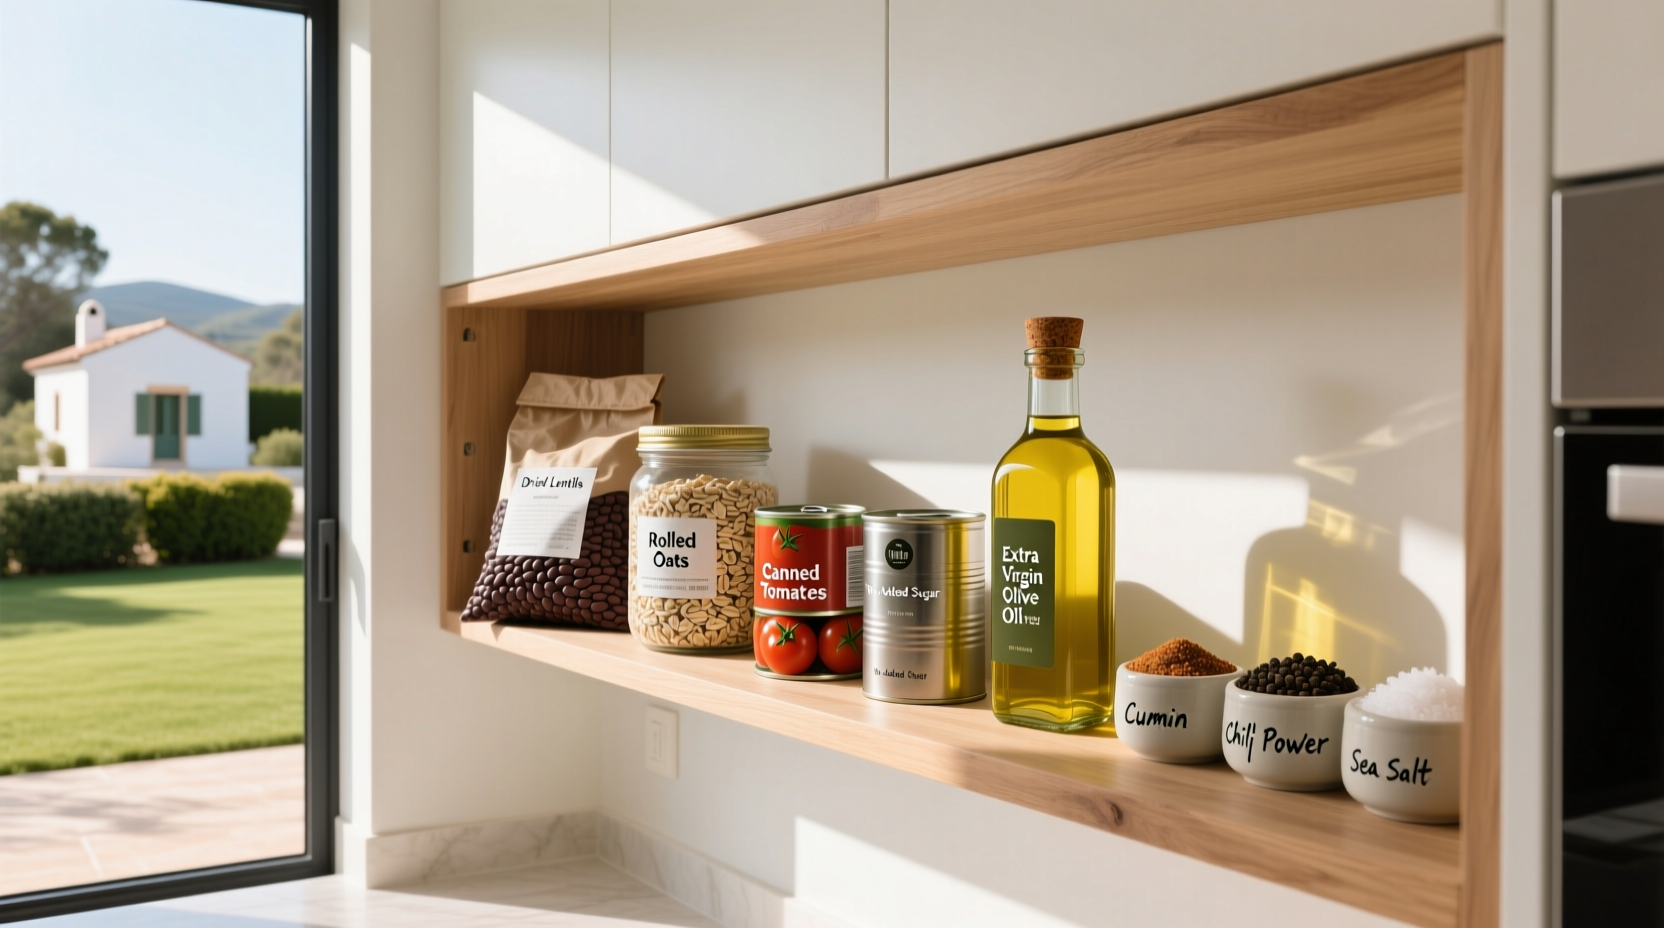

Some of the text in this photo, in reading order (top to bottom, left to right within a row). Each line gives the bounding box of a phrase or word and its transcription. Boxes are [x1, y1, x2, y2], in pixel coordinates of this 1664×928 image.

[649, 531, 696, 549] Rolled
[653, 550, 690, 568] Oats
[1002, 546, 1039, 563] Extra
[762, 562, 820, 580] Canned
[760, 581, 827, 600] Tomates
[1262, 727, 1330, 754] Power
[1350, 749, 1432, 786] Sea Salt
